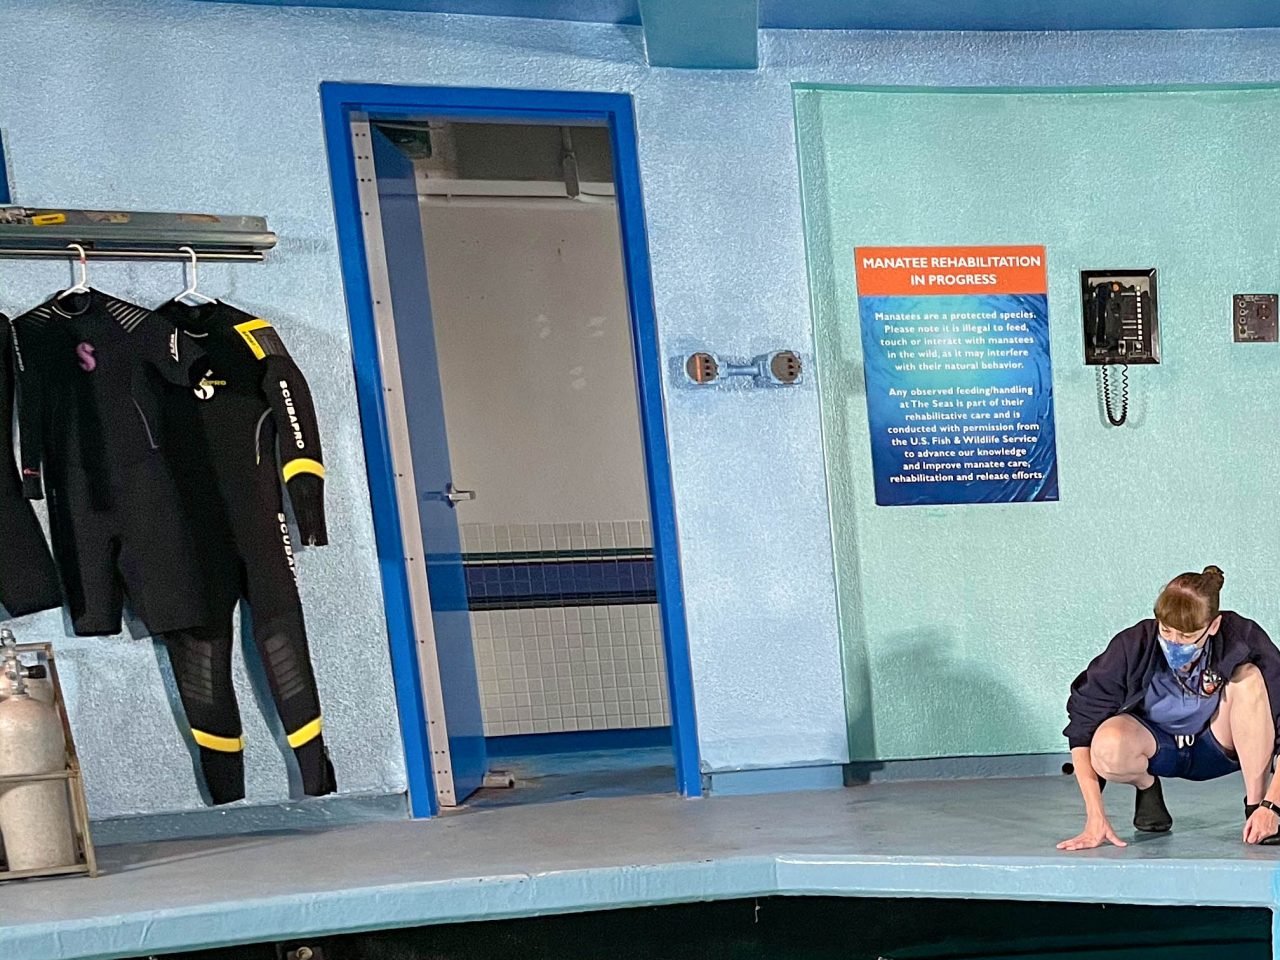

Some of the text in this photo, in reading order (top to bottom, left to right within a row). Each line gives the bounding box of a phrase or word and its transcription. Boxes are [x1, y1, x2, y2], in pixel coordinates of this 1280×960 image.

[863, 257, 1040, 268] MANATEE REHABILITATION
[911, 275, 996, 285] IN PROGRESS
[951, 311, 996, 321] protected
[1000, 311, 1036, 320] species.
[885, 325, 915, 333] Please
[962, 325, 990, 334] illegal
[1007, 324, 1029, 332] feed,
[881, 338, 907, 346] touch
[900, 350, 915, 358] the
[918, 350, 940, 358] wild,
[965, 350, 984, 359] may
[919, 362, 941, 370] their
[945, 362, 978, 370] natural
[982, 361, 1023, 369] behavior.
[889, 386, 1033, 397] Any observed feeding/handling
[912, 400, 929, 408] The
[933, 400, 953, 408] Seas
[967, 400, 986, 409] part
[279, 380, 305, 449] SCUBAPRO
[906, 412, 968, 420] rehabilitative
[888, 425, 936, 433] conducted
[940, 424, 960, 432] with
[963, 423, 1014, 433] permission
[892, 438, 907, 446] the
[911, 437, 929, 445] U.S.
[963, 436, 999, 444] Wildlife
[905, 450, 914, 458] to
[977, 448, 1026, 457] knowledge
[903, 460, 1030, 471] and improve manatee care,
[890, 474, 953, 483] rehabilitation
[977, 472, 1009, 480] release
[1012, 471, 1044, 480] efforts.
